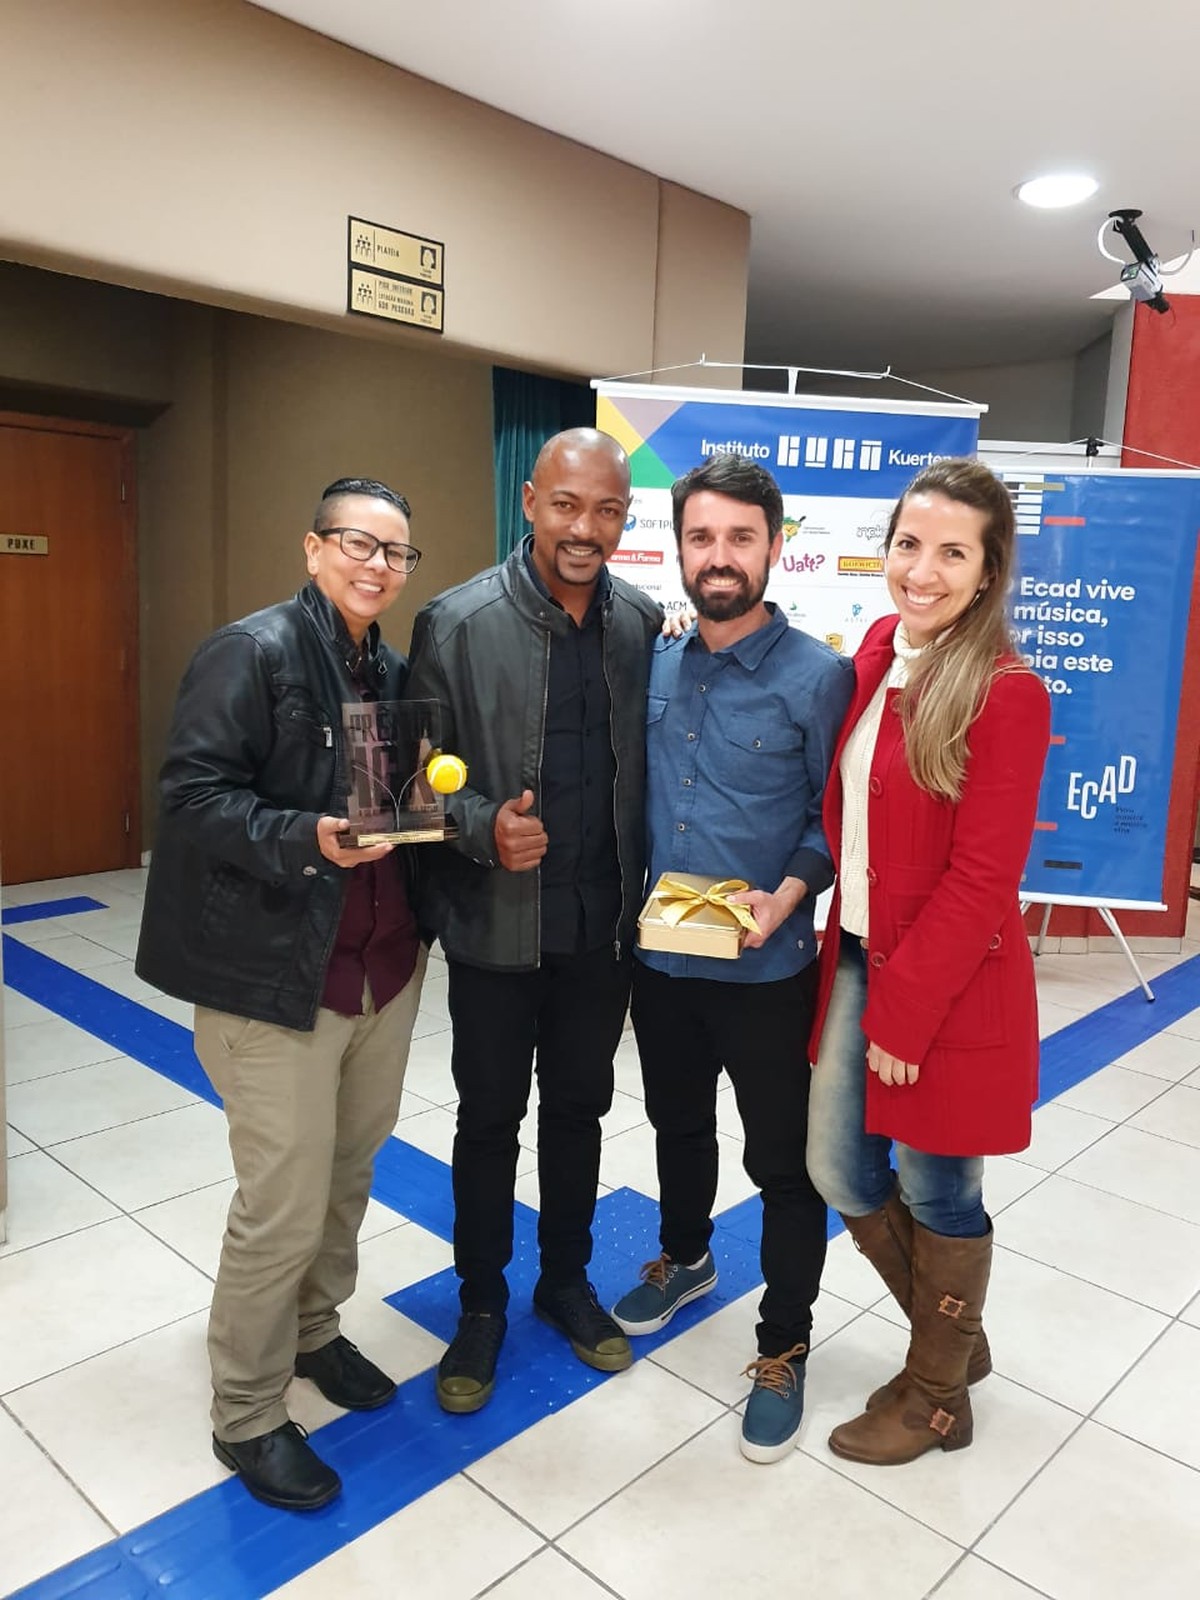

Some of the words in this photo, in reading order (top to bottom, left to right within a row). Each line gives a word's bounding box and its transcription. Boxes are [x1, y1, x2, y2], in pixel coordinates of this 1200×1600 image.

[701, 439, 770, 459] Instituto
[782, 553, 826, 573] Uatt?
[1020, 576, 1081, 598] Ecad
[1086, 579, 1135, 601] vive
[1013, 601, 1108, 628] música,
[1037, 625, 1084, 647] isso
[1063, 655, 1113, 673] este
[1067, 754, 1137, 820] ECAD
